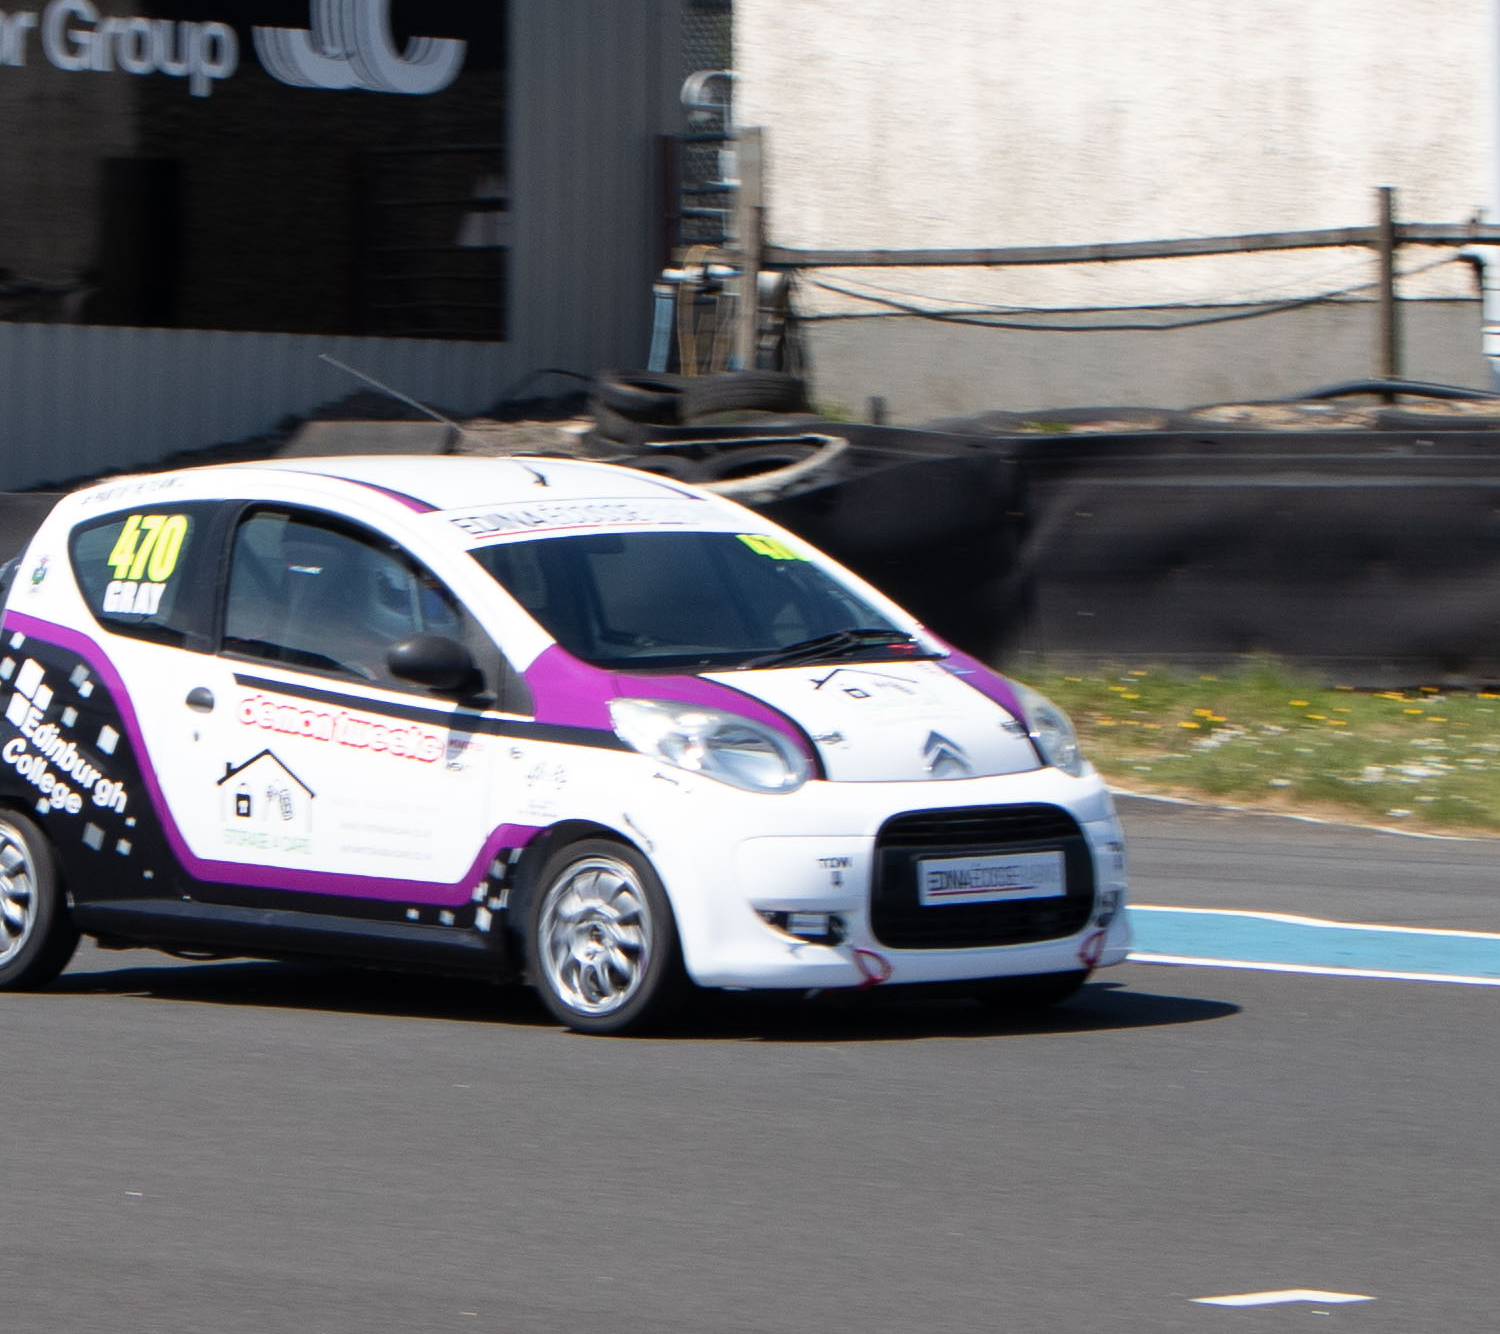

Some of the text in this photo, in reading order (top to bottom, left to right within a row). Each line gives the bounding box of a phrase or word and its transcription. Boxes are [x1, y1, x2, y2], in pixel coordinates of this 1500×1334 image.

[106, 514, 189, 583] 470
[103, 580, 167, 616] GRAY
[236, 693, 333, 742] demon
[1, 737, 84, 815] College
[19, 705, 129, 814] Edinburgh
